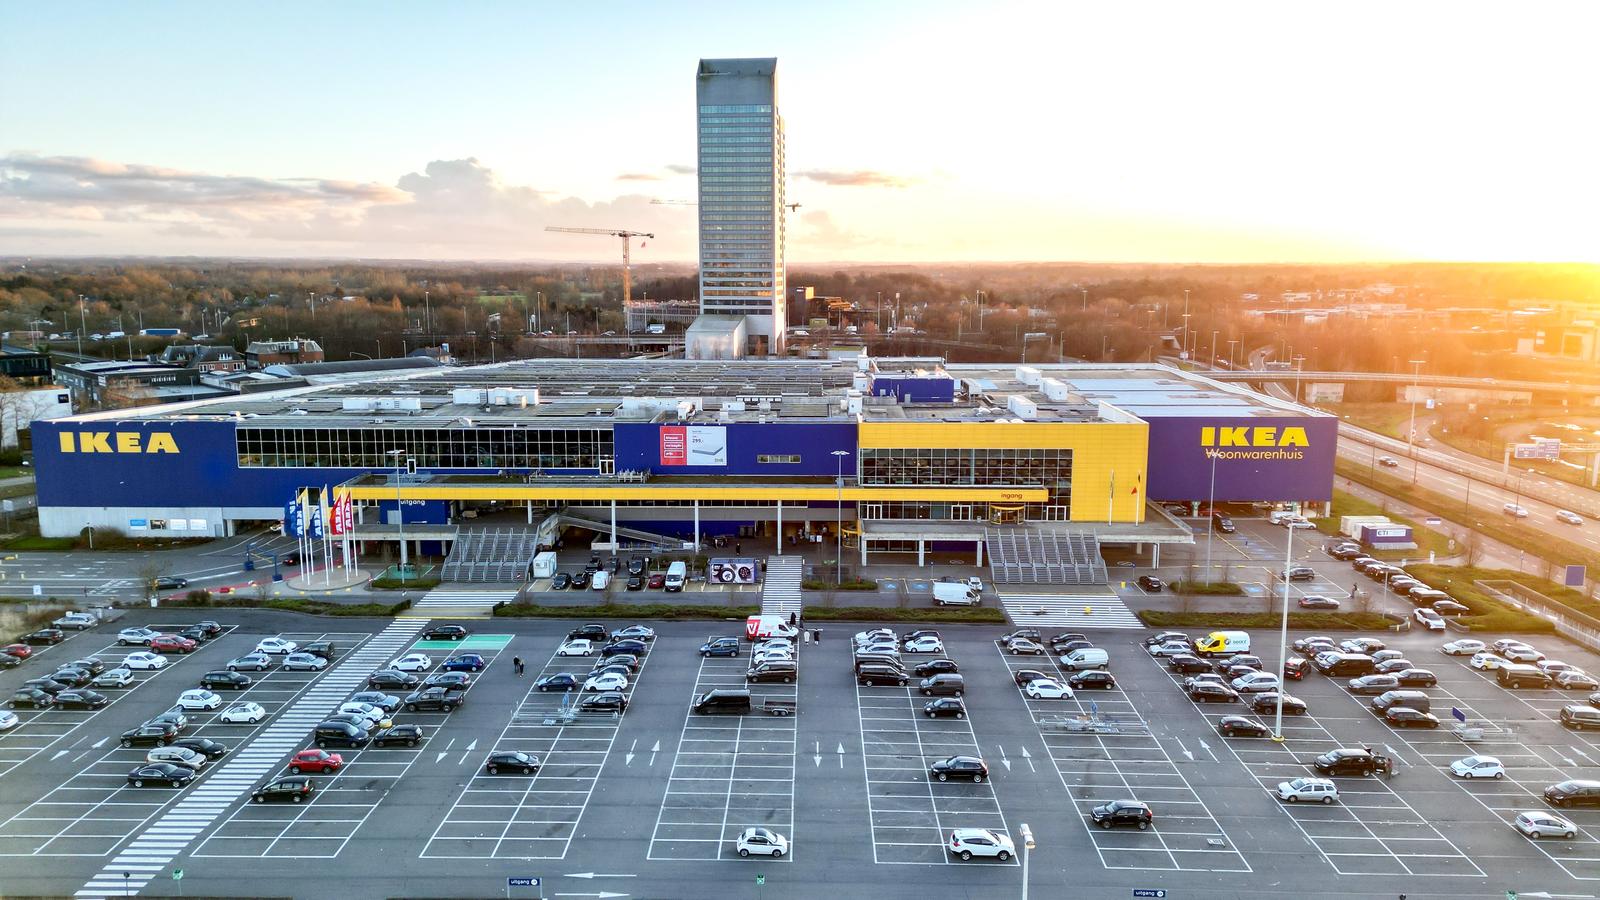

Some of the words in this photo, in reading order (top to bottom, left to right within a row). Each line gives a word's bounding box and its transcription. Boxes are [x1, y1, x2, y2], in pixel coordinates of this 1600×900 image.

[59, 432, 180, 453] IKEA
[1201, 427, 1310, 446] IKEA
[1205, 448, 1304, 459] Woonwarenhuis
